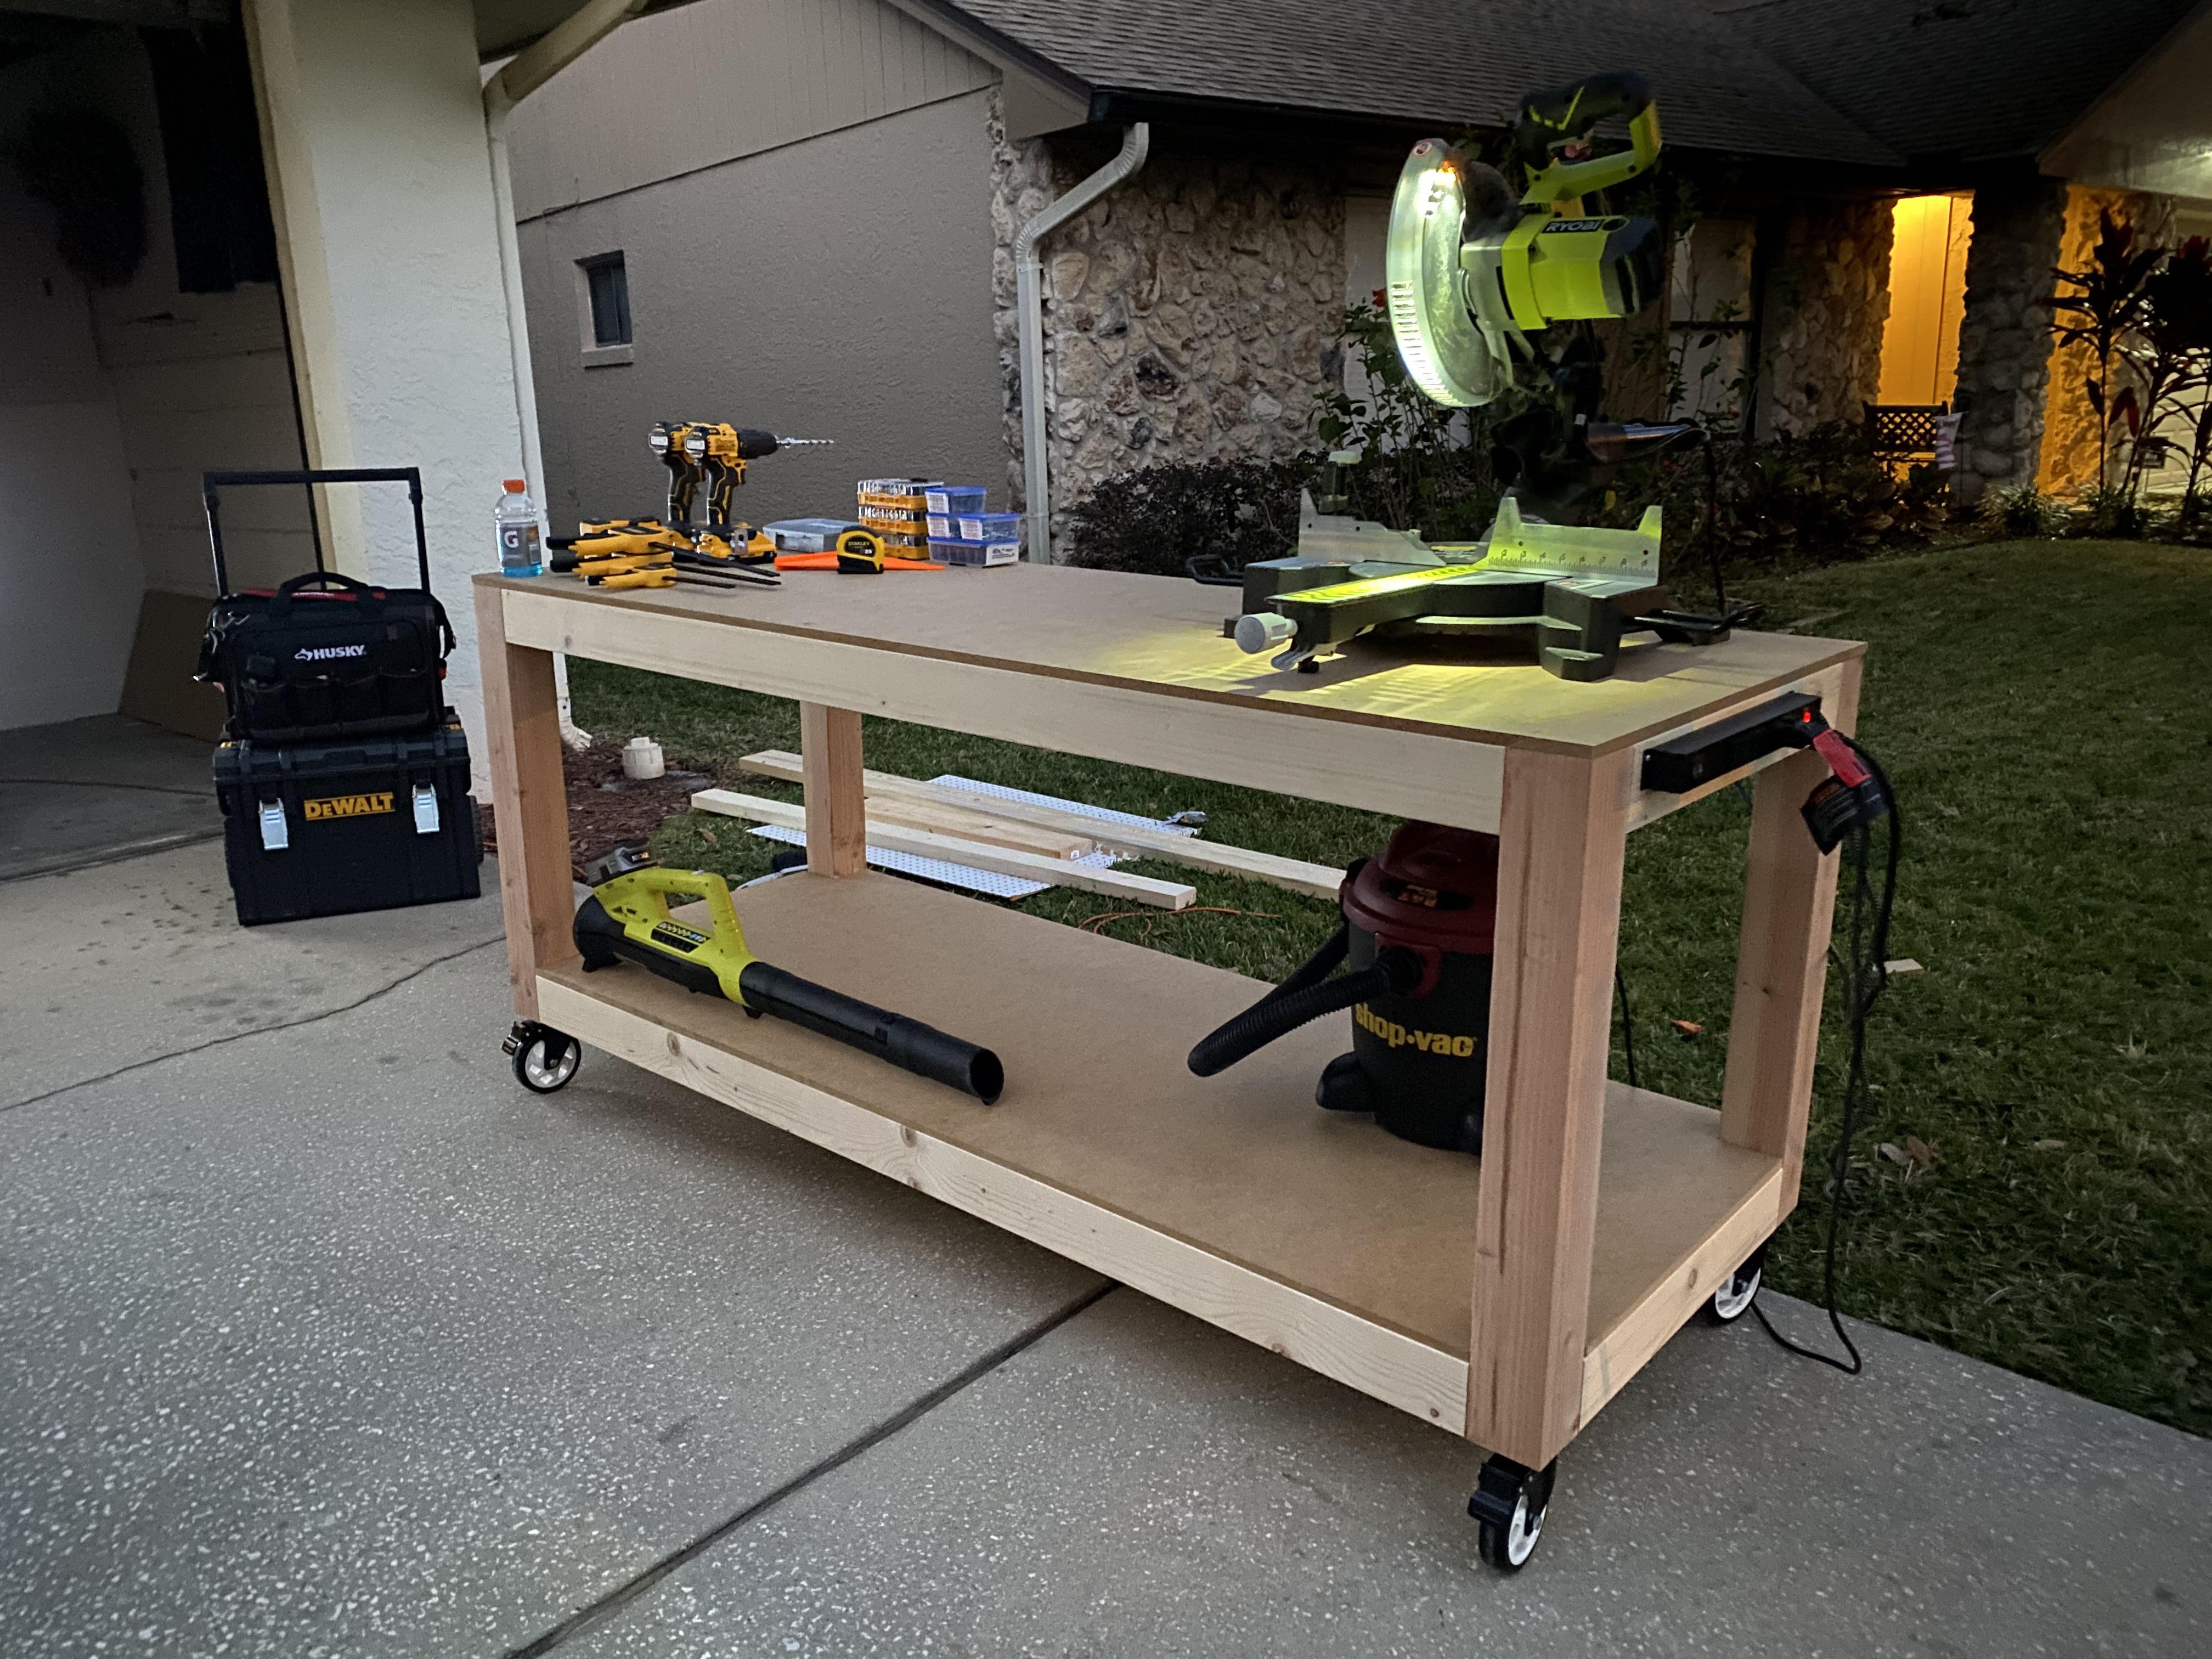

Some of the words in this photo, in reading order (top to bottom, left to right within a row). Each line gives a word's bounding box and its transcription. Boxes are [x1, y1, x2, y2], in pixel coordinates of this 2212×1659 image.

[1545, 221, 1600, 232] RYOBI
[504, 531, 518, 548] G
[313, 645, 365, 660] HUSKY
[304, 794, 394, 818] DEWALT
